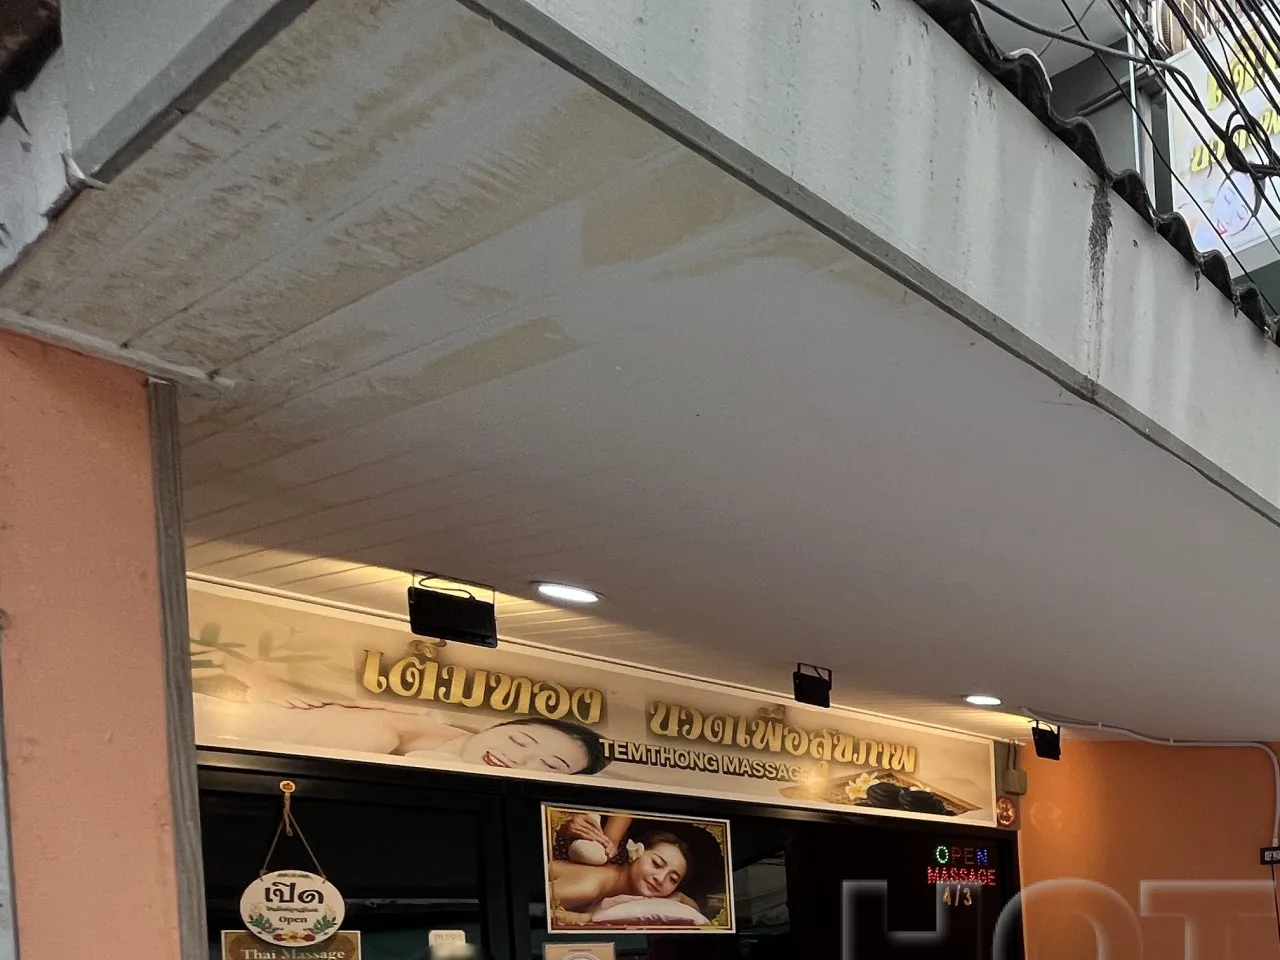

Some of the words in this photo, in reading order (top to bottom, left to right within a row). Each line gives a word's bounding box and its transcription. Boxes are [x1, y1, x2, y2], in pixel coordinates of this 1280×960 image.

[363, 640, 603, 724] เต็มทอง
[650, 701, 917, 783] นวดเพื่อสุขภาพ
[599, 738, 718, 773] TEMTHONG
[936, 845, 988, 865] OPEN
[927, 867, 996, 885] MASSAGE
[265, 881, 324, 904] เปิด
[943, 885, 972, 906] 4/3
[279, 916, 307, 925] Open
[240, 949, 276, 960] Thai
